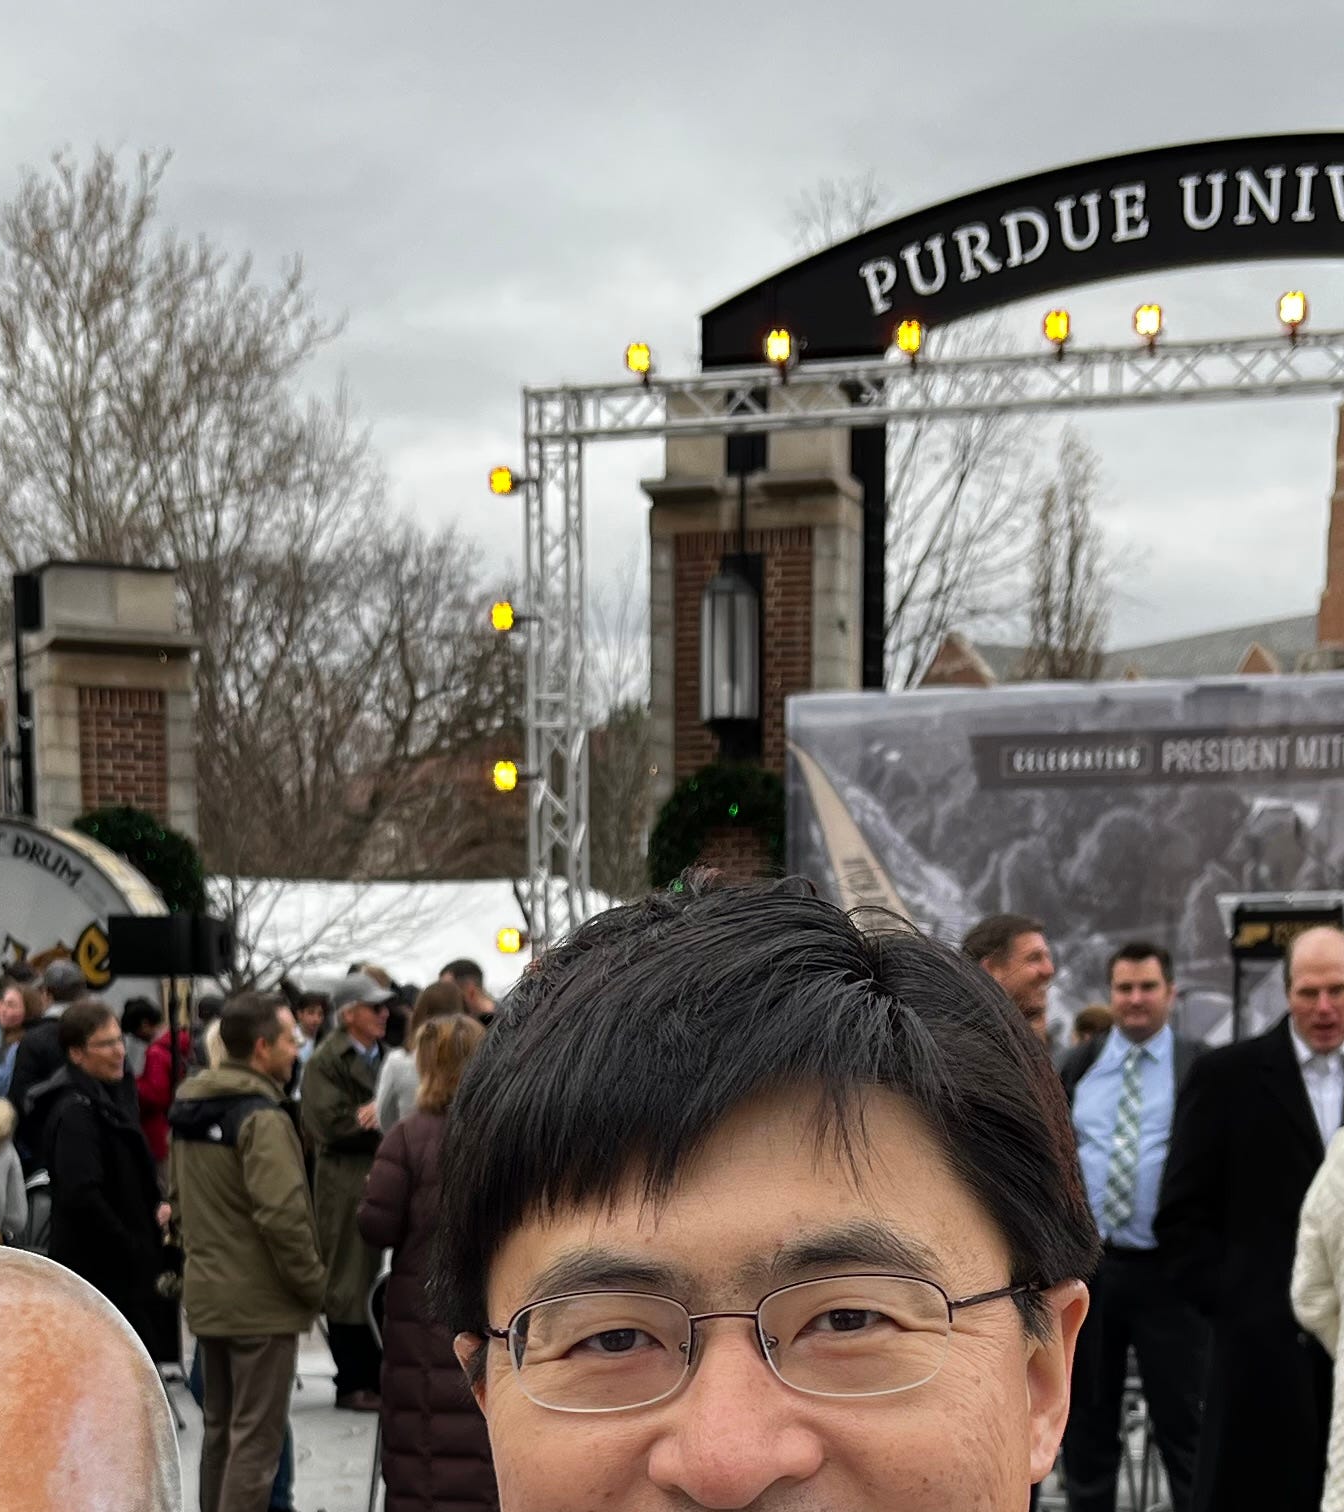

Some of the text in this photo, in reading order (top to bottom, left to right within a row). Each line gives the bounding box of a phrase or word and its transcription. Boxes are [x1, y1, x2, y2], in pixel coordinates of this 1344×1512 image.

[859, 180, 1150, 317] PURDUE
[1161, 736, 1291, 773] PRESIDENT
[12, 835, 84, 888] DRUM
